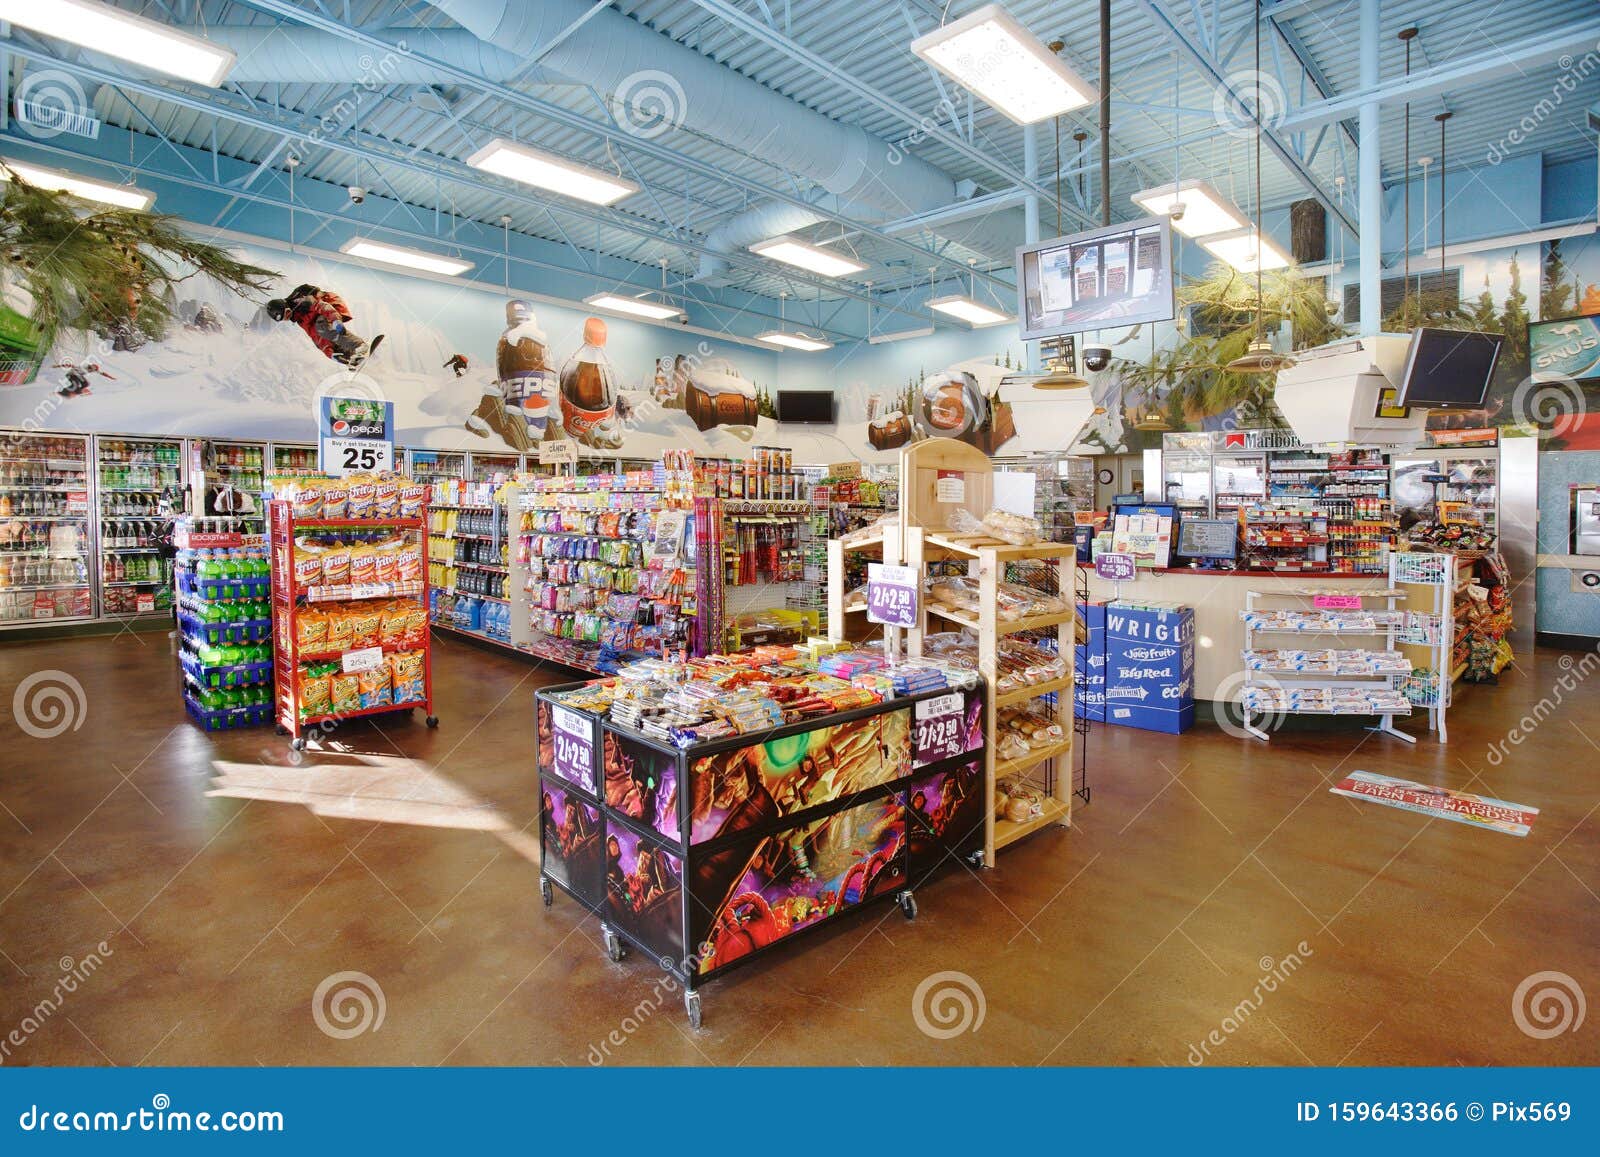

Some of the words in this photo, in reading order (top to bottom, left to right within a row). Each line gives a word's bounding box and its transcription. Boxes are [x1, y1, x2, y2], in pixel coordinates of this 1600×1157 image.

[1536, 336, 1598, 368] SNUS
[501, 377, 556, 400] PEPS
[351, 425, 383, 435] pepsi
[1106, 555, 1123, 563] EXTRA
[1119, 667, 1142, 680] Big
[1144, 667, 1173, 679] Red
[918, 718, 957, 751] 2/$2.50
[1352, 786, 1404, 801] EARN
[1415, 796, 1523, 823] REWARDS!
